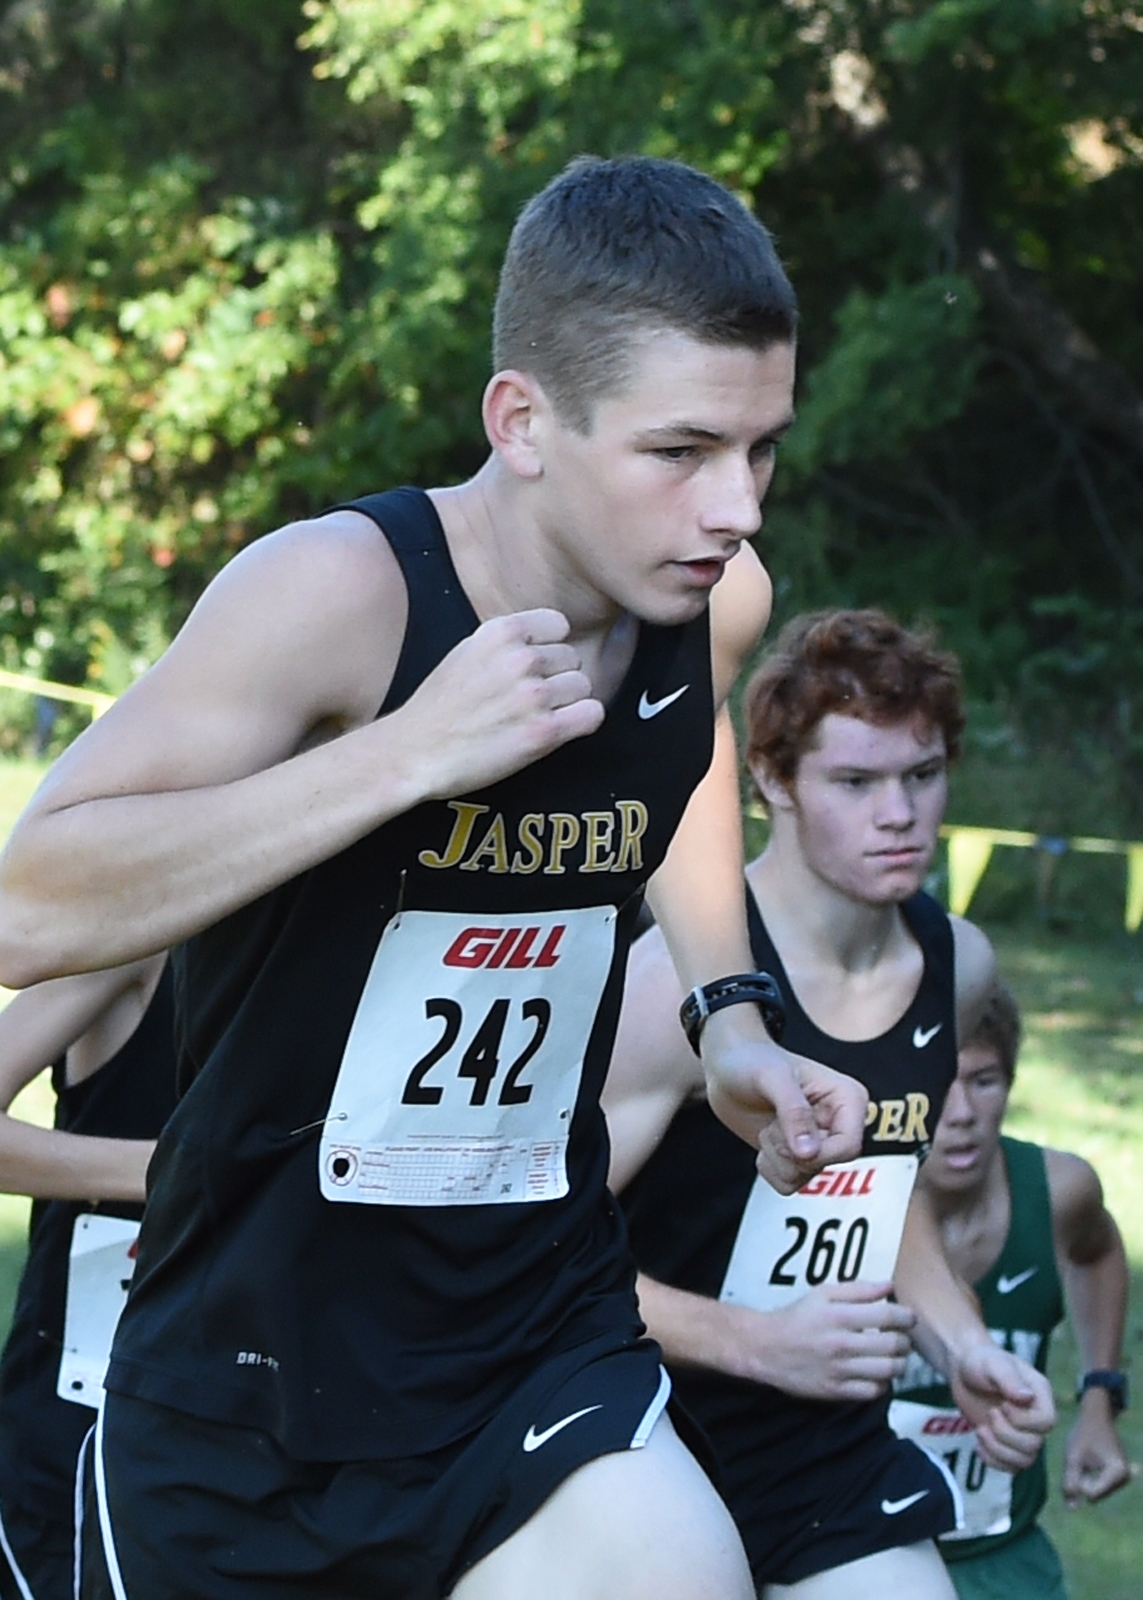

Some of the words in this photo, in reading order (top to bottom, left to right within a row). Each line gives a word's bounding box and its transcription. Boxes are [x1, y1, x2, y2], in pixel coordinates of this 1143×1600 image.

[418, 800, 649, 874] JASPER
[443, 925, 567, 969] GILL
[401, 997, 551, 1106] 242
[768, 1216, 869, 1286] 260
